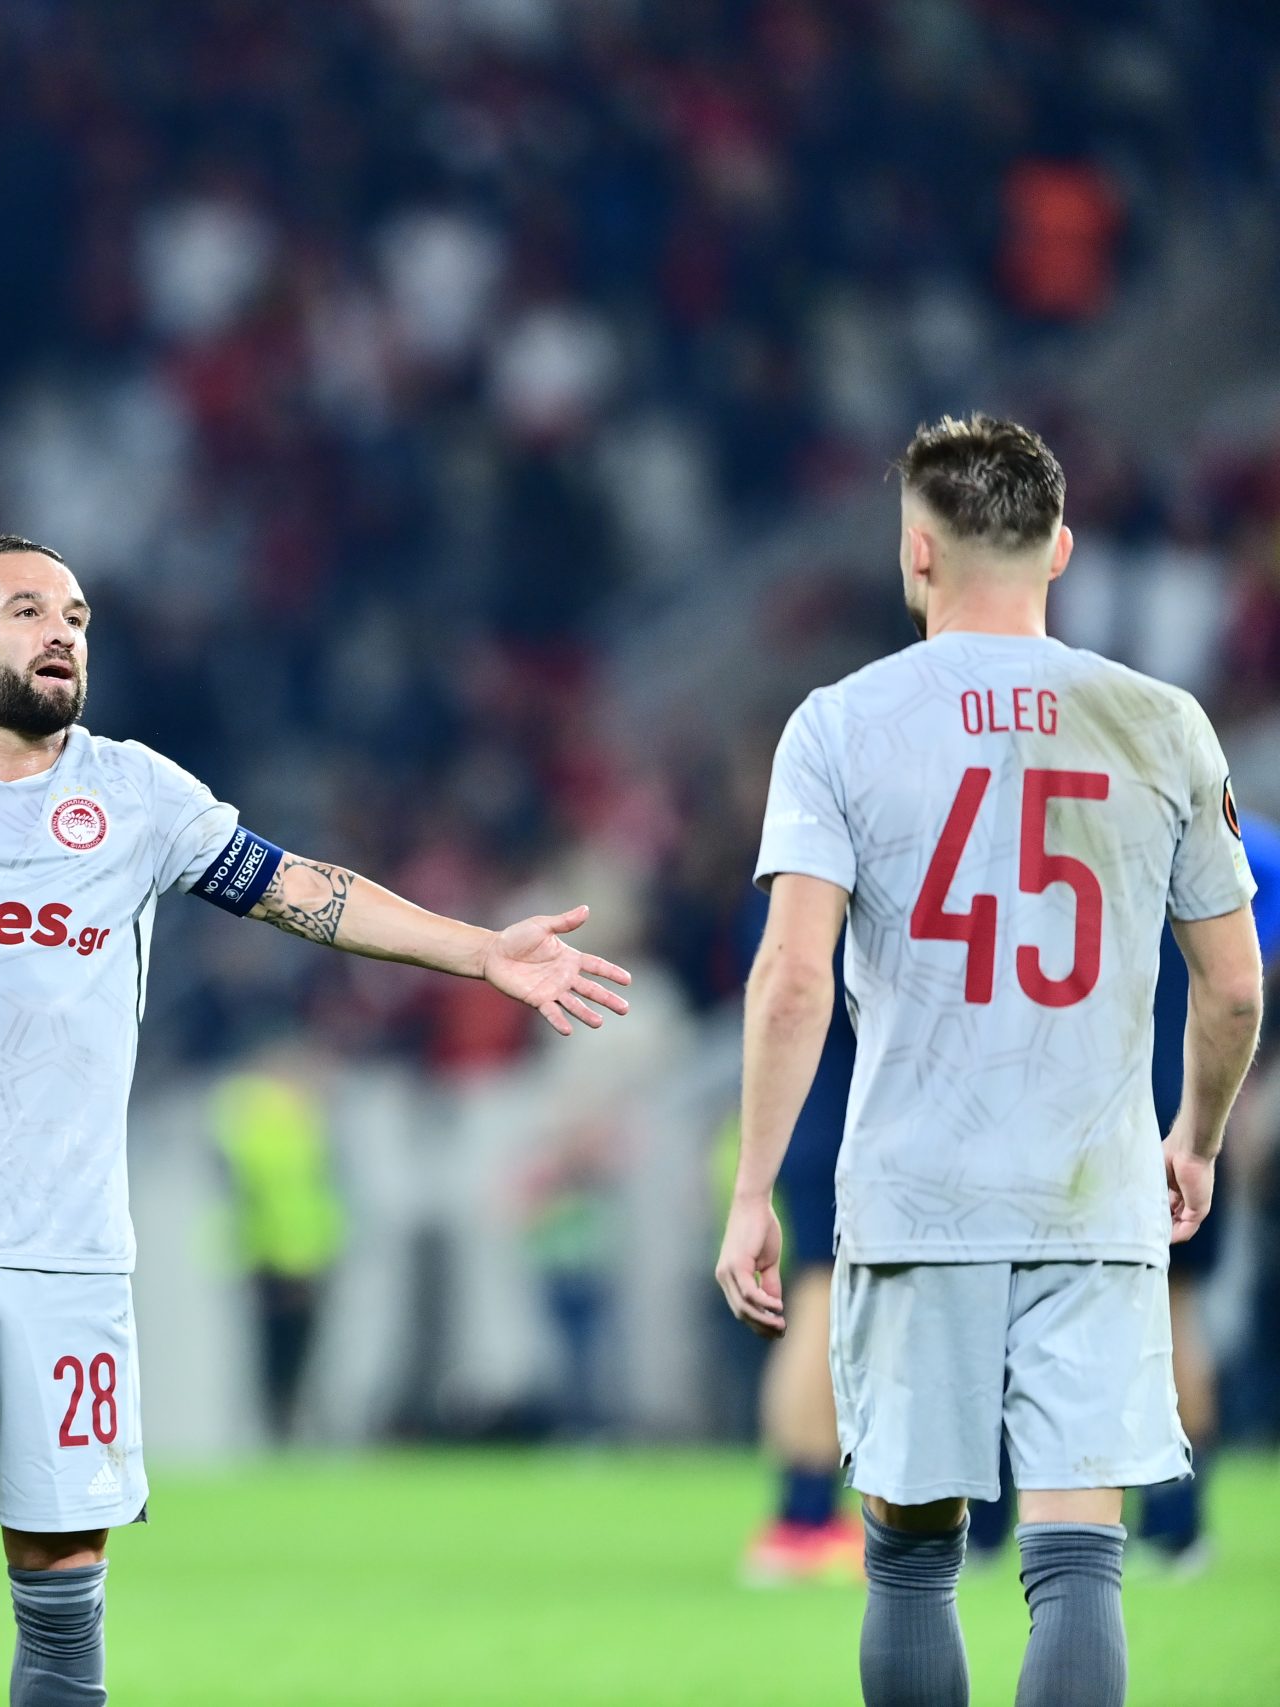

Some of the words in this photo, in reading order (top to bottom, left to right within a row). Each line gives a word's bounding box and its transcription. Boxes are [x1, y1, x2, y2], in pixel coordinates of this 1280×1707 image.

[961, 687, 1058, 735] OLEG
[204, 880, 219, 894] NO
[213, 866, 229, 881] TO
[223, 830, 248, 867] RACISM
[234, 843, 264, 889] RESPECT
[910, 767, 1110, 1008] 45
[53, 1352, 118, 1448] 28
